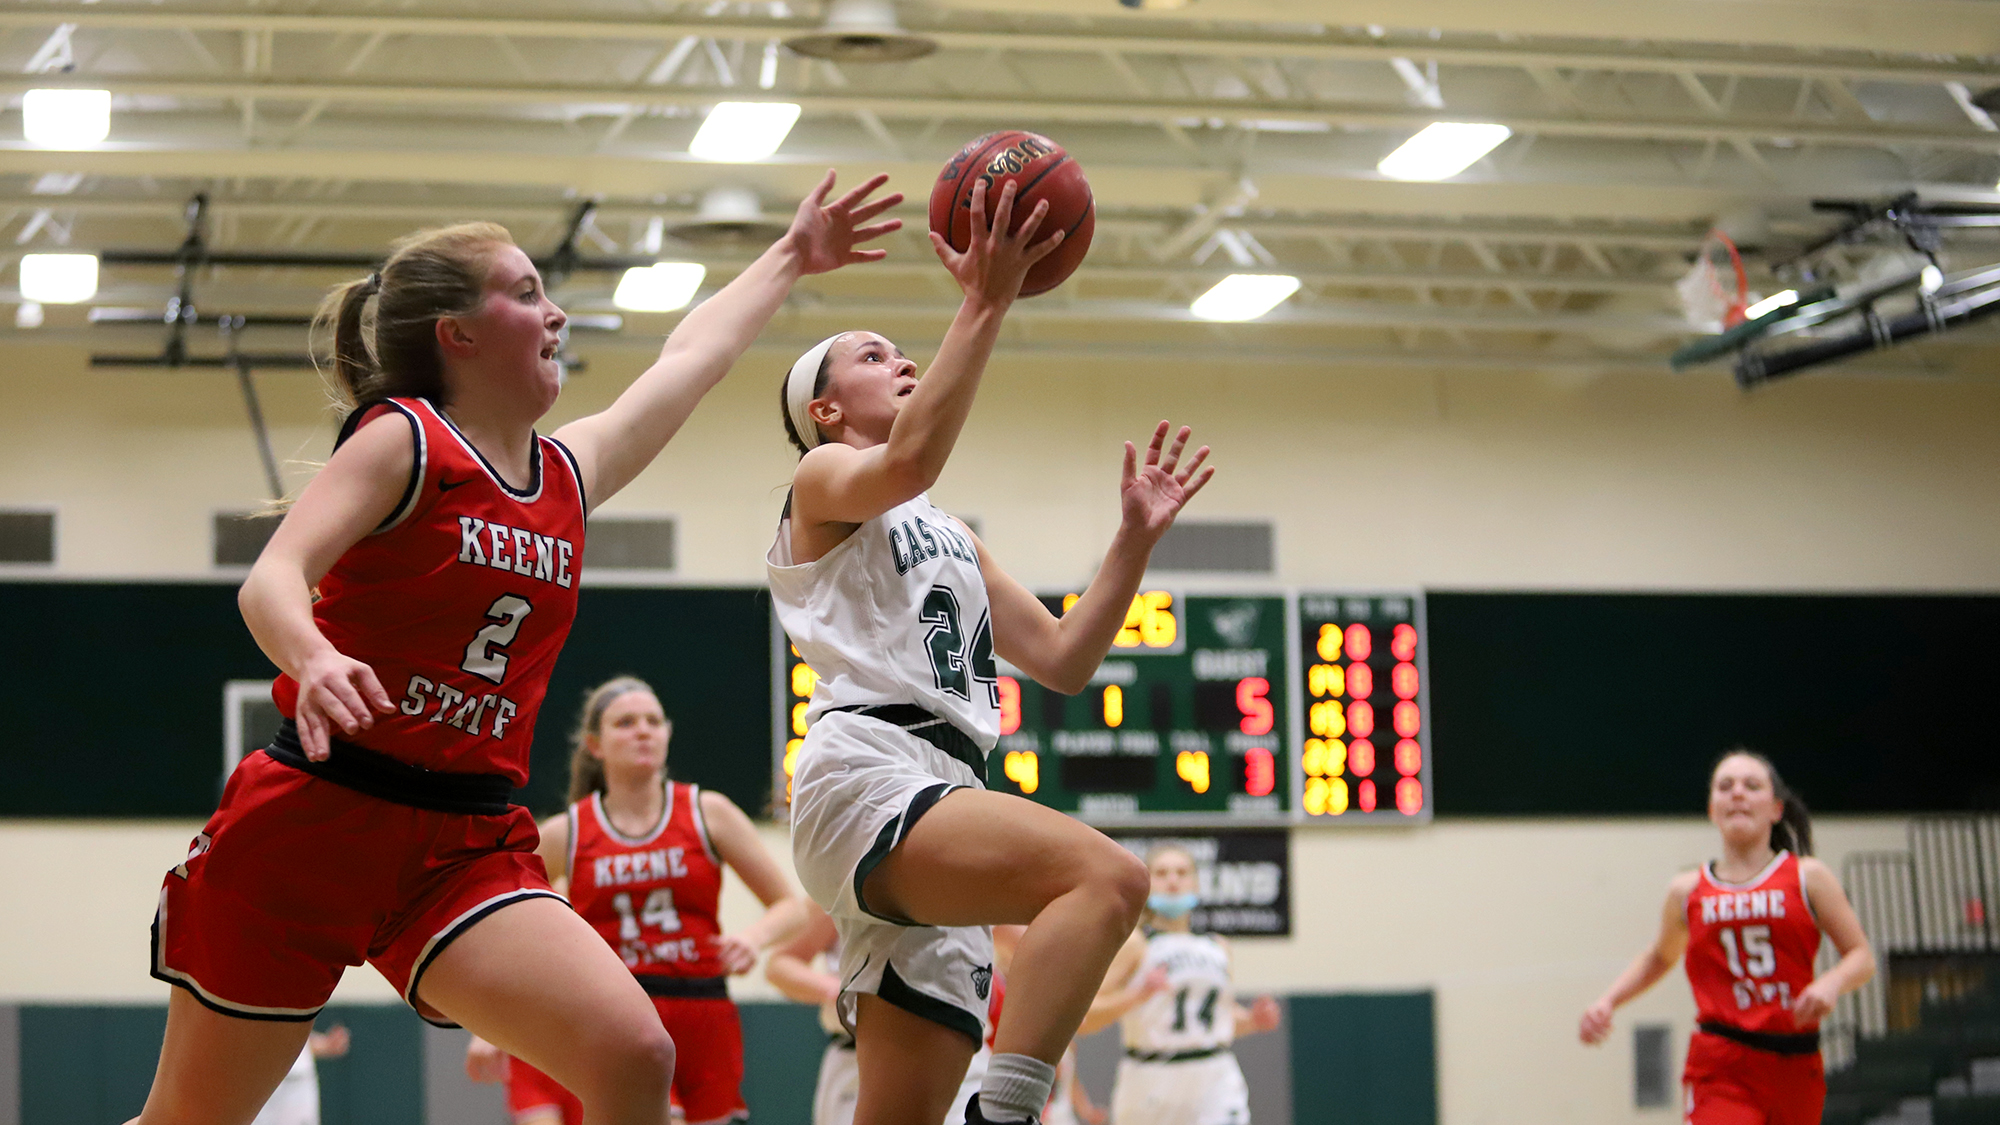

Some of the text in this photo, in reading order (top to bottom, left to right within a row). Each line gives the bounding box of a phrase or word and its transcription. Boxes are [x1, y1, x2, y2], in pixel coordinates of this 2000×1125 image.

[457, 515, 573, 589] KEENE
[459, 592, 533, 686] 2
[919, 584, 1000, 709] 24
[1103, 685, 1123, 728] 1
[1236, 677, 1274, 736] 5
[1004, 751, 1038, 794] 4
[1176, 751, 1210, 794] 4
[1245, 747, 1275, 796] 3
[594, 847, 688, 887] KEENE
[612, 888, 682, 940] 14
[1701, 889, 1785, 924] KEENE
[1719, 924, 1776, 978] 15
[1170, 985, 1220, 1033] 14
